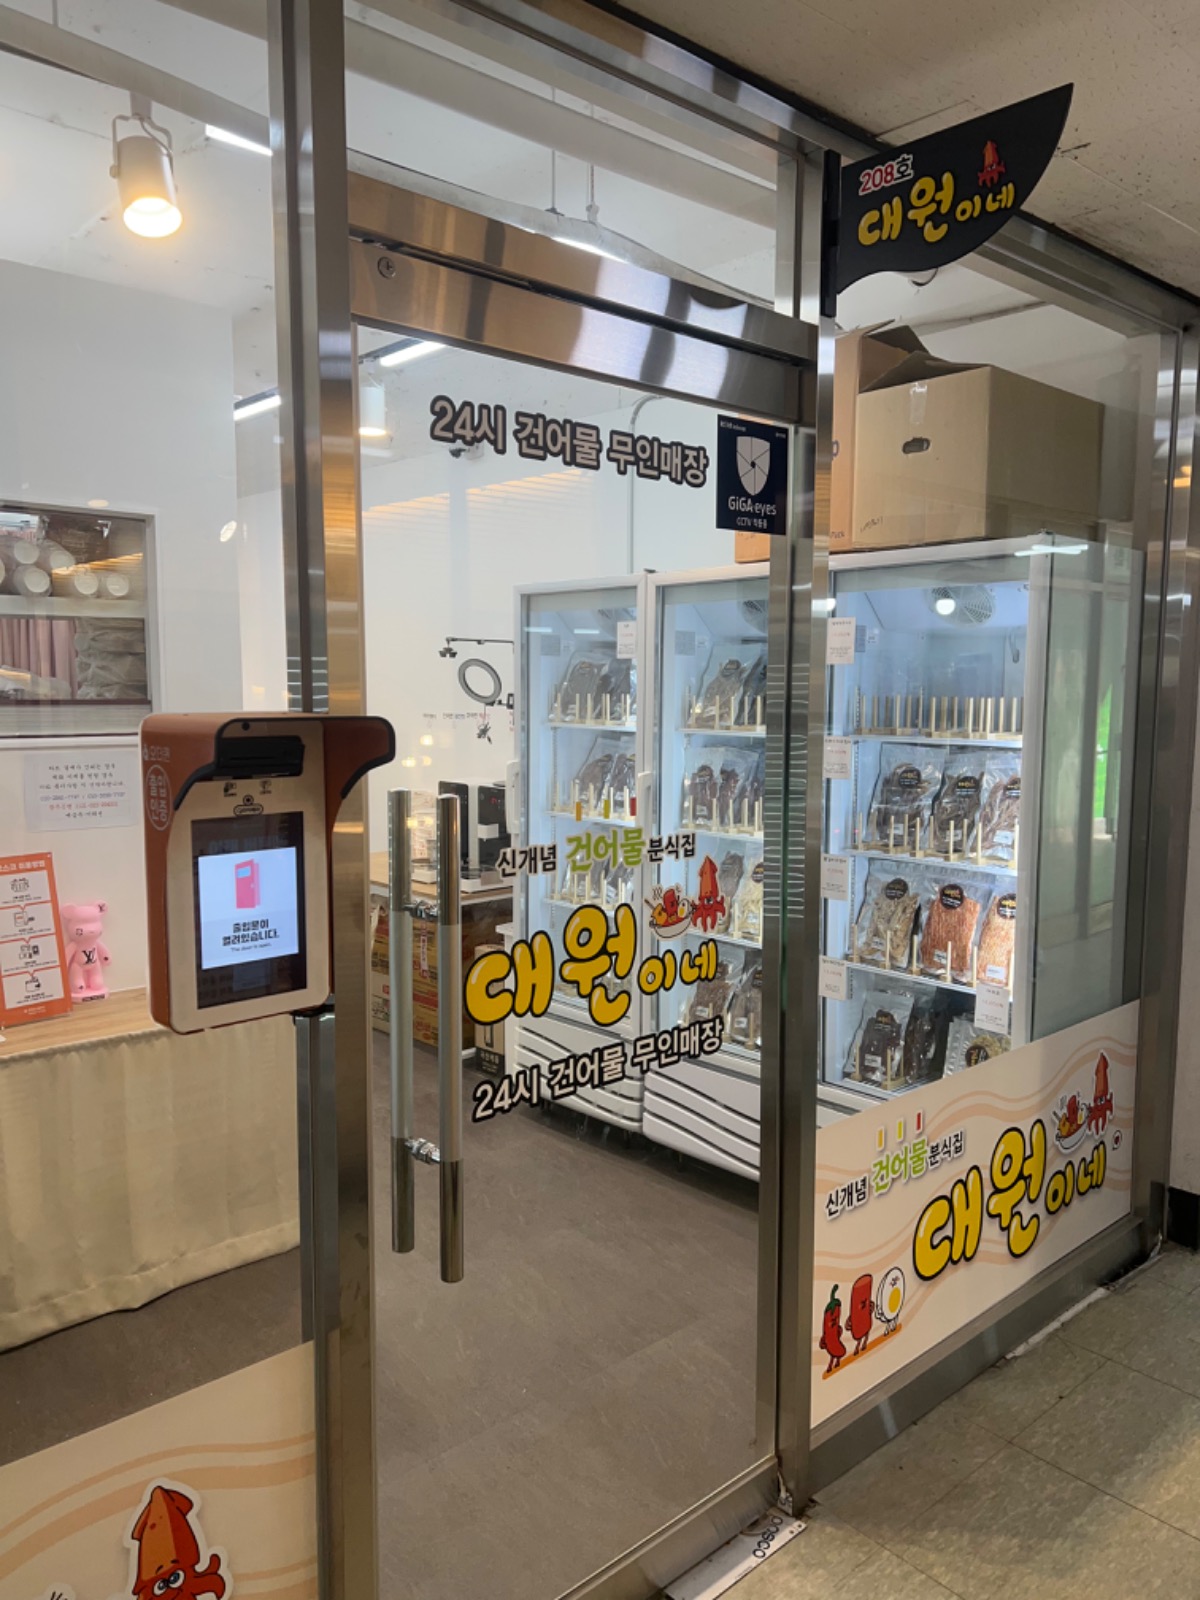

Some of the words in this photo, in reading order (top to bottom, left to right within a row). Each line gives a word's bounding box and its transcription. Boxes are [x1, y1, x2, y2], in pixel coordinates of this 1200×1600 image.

[858, 153, 914, 196] 208호
[858, 171, 1015, 246] 대원이네
[429, 394, 507, 455] 24시
[513, 410, 602, 471] 건어물
[606, 429, 710, 488] 무인매장
[497, 843, 558, 878] 신개념
[565, 826, 646, 874] 건어물
[646, 831, 697, 863] 분식집
[232, 918, 269, 934] 출입문이
[464, 902, 718, 1026] 대원이네
[472, 1064, 541, 1123] 24시
[548, 1042, 627, 1101] 건어물
[631, 1014, 726, 1075] 무인매장
[824, 1174, 869, 1219] 신개념
[870, 1135, 930, 1197] 건어물
[927, 1129, 966, 1170] 분식집
[912, 1117, 1108, 1283] 대원이네
